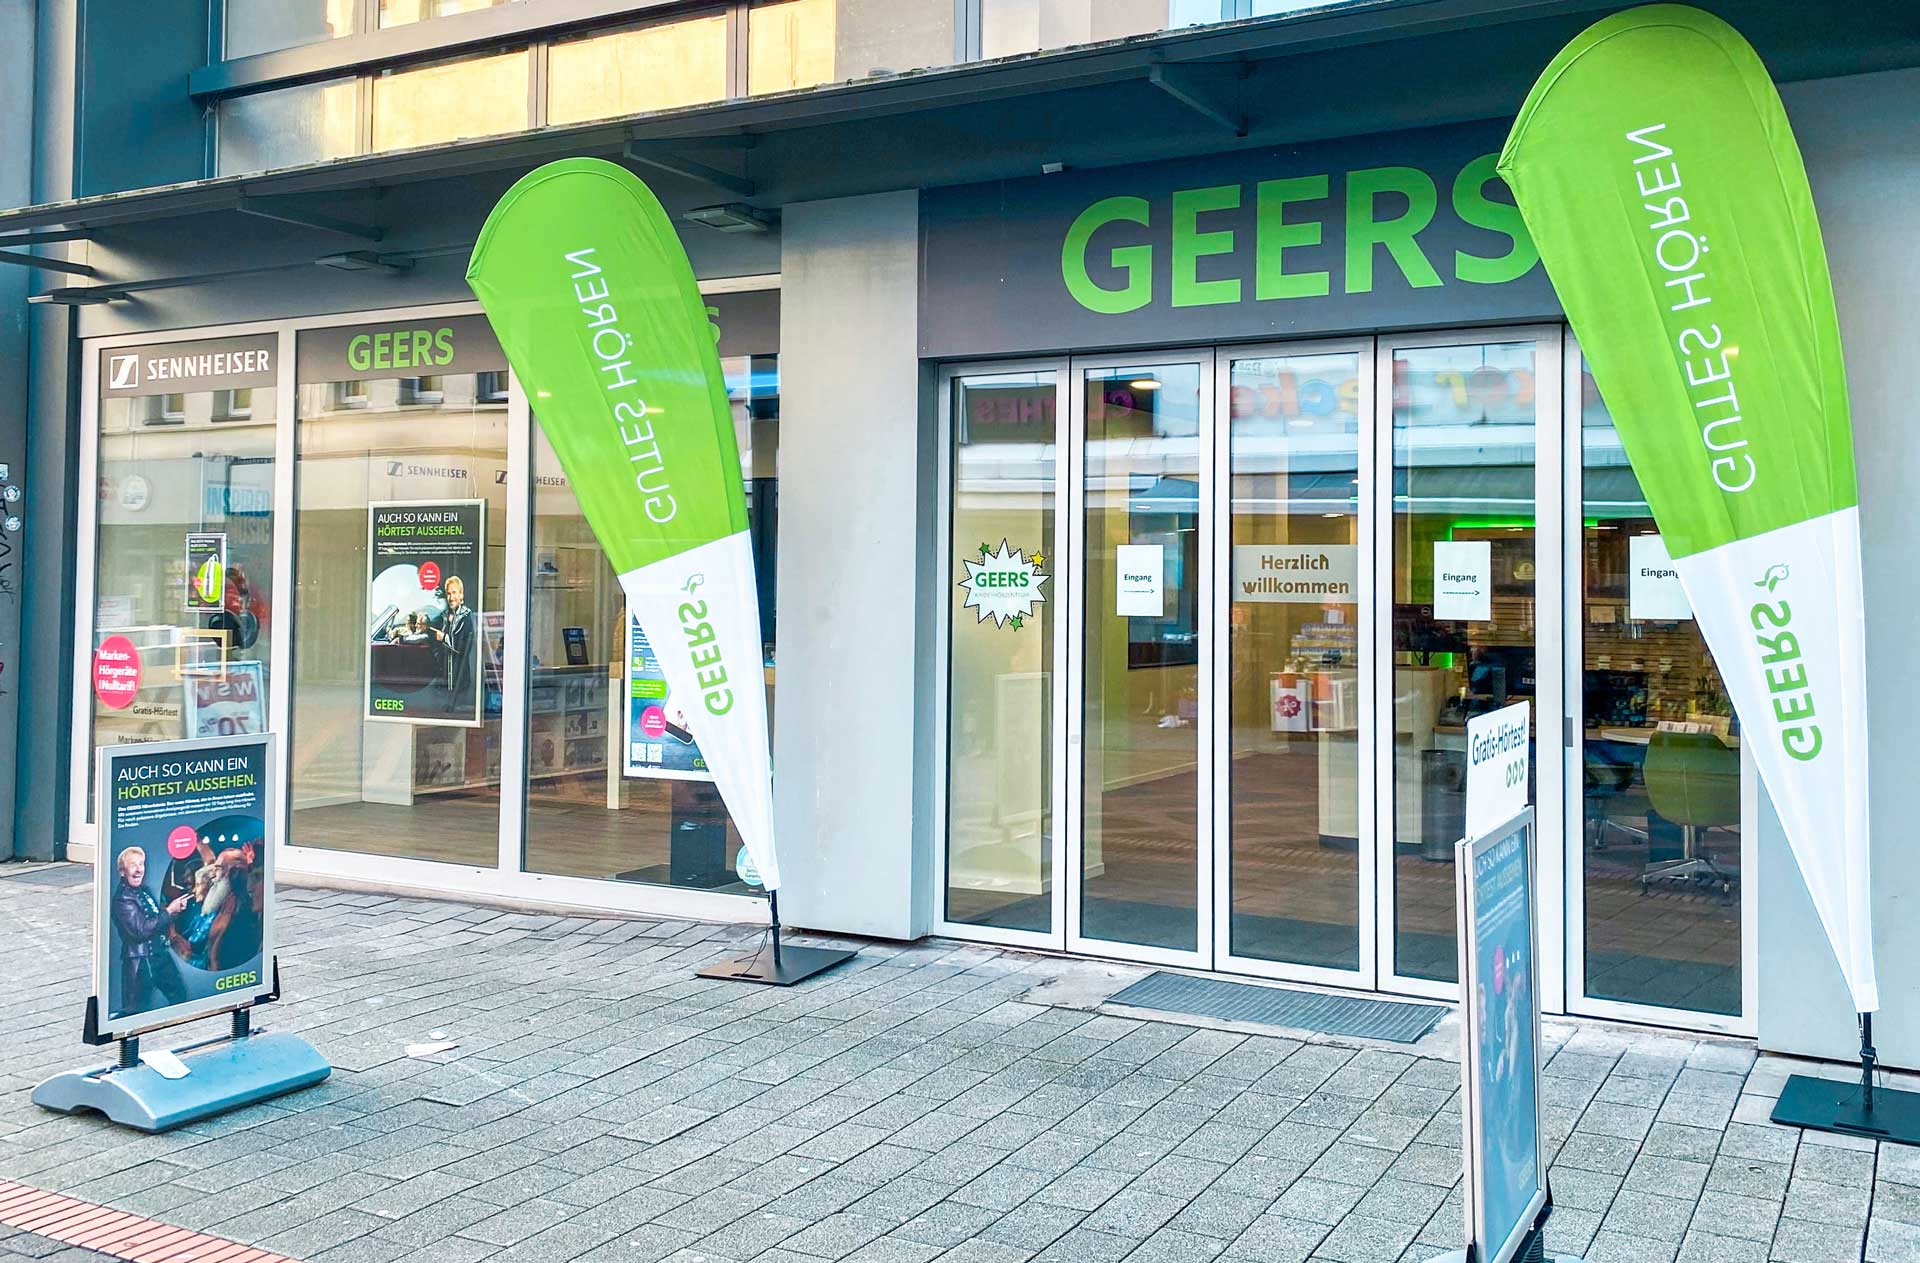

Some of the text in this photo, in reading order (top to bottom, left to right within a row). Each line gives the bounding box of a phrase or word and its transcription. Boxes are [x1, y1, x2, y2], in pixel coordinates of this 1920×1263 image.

[1061, 153, 1541, 315] GEERS
[348, 328, 454, 371] GEERS
[147, 350, 269, 380] SENNHEISER
[407, 465, 468, 479] SENNHEISER
[536, 476, 566, 486] HEISER
[378, 512, 458, 523] AUCH SO KANN EIN
[377, 525, 465, 536] HÖRTEST AUSSEHEN.
[1261, 554, 1329, 570] Herzlich
[975, 572, 1029, 587] GEERS
[1124, 573, 1152, 583] Eingang
[1443, 573, 1477, 583] Eingang
[1242, 577, 1349, 594] willkommen
[99, 650, 130, 661] Marken-
[98, 665, 137, 678] Hörgeräte
[133, 704, 178, 717] Gratis-Hörtest
[375, 699, 404, 711] GEERS
[1473, 717, 1525, 766] Gratis-Hörtest!
[118, 757, 248, 782] AUCH SO KANN EIN
[118, 774, 257, 800] HÖRTEST AUSSEHEN.
[215, 970, 257, 990] GEERS
